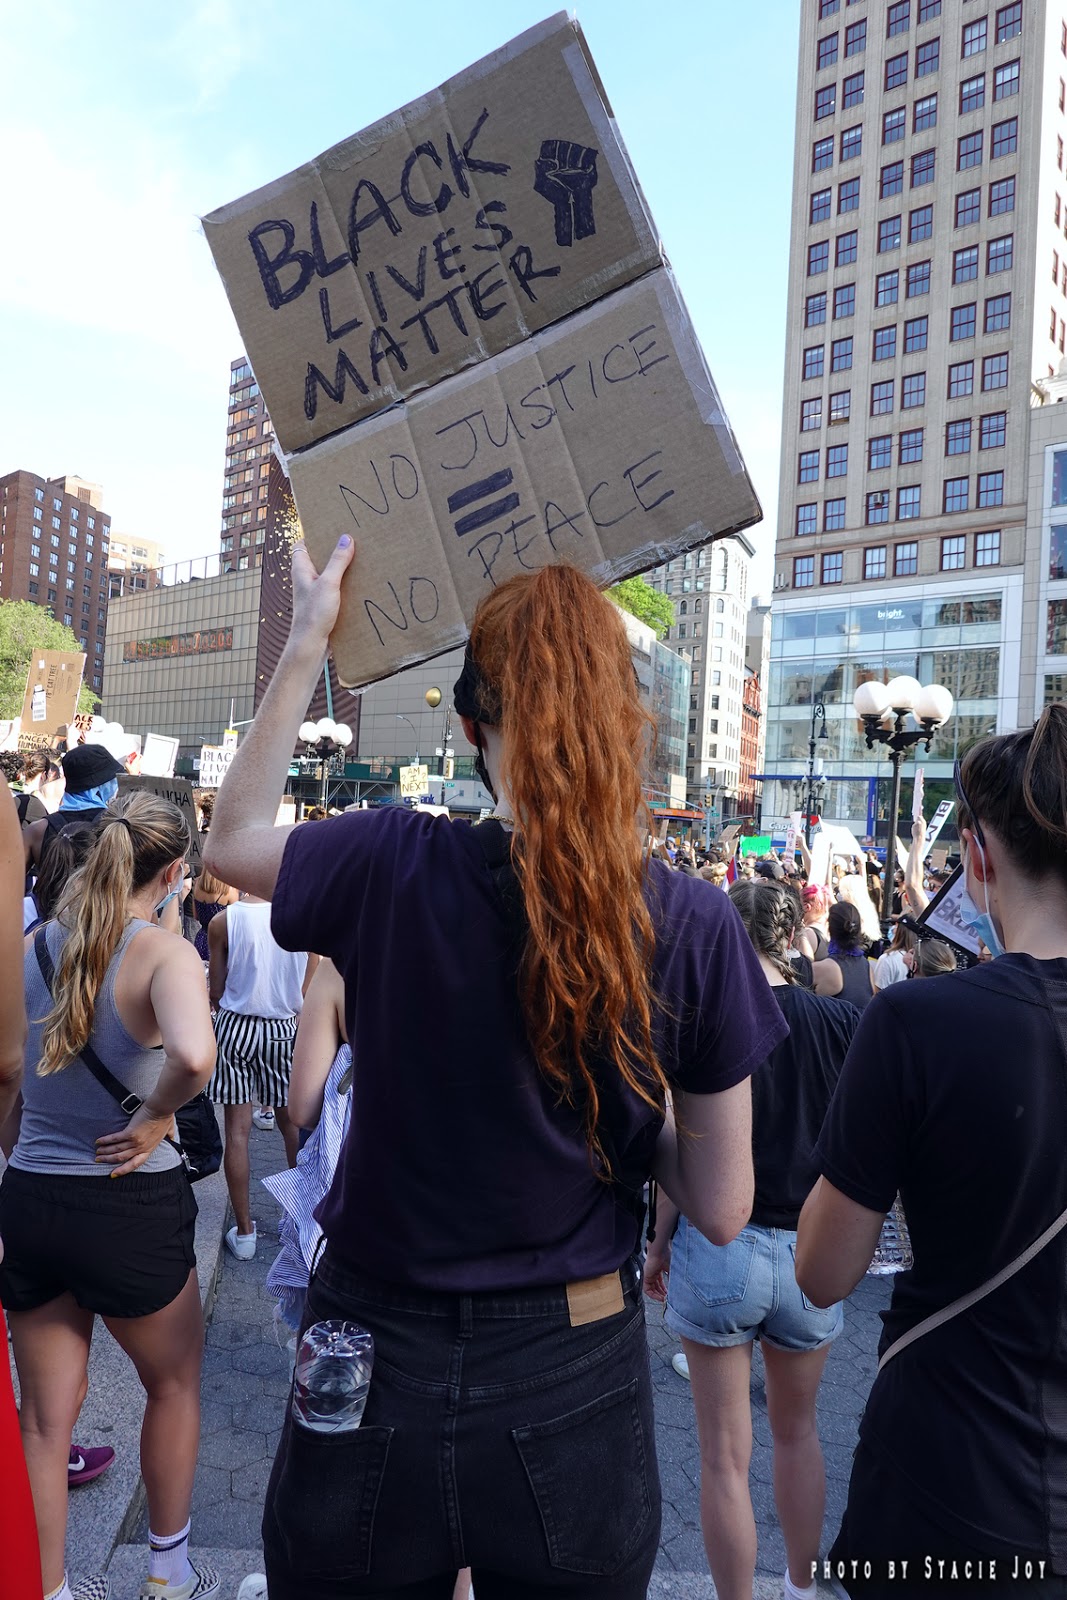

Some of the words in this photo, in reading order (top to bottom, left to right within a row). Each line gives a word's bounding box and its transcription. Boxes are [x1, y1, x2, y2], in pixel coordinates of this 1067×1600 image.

[248, 107, 511, 310] BLACK
[319, 201, 513, 343] LIVES
[304, 245, 561, 420] MATTER
[339, 454, 419, 528] NO
[435, 325, 670, 470] JUSTICE
[364, 576, 439, 646] NO
[467, 451, 674, 587] PEACE
[204, 751, 233, 762] BLAC
[402, 781, 428, 792] NEXT
[407, 766, 420, 775] AM
[925, 801, 951, 843] BLM
